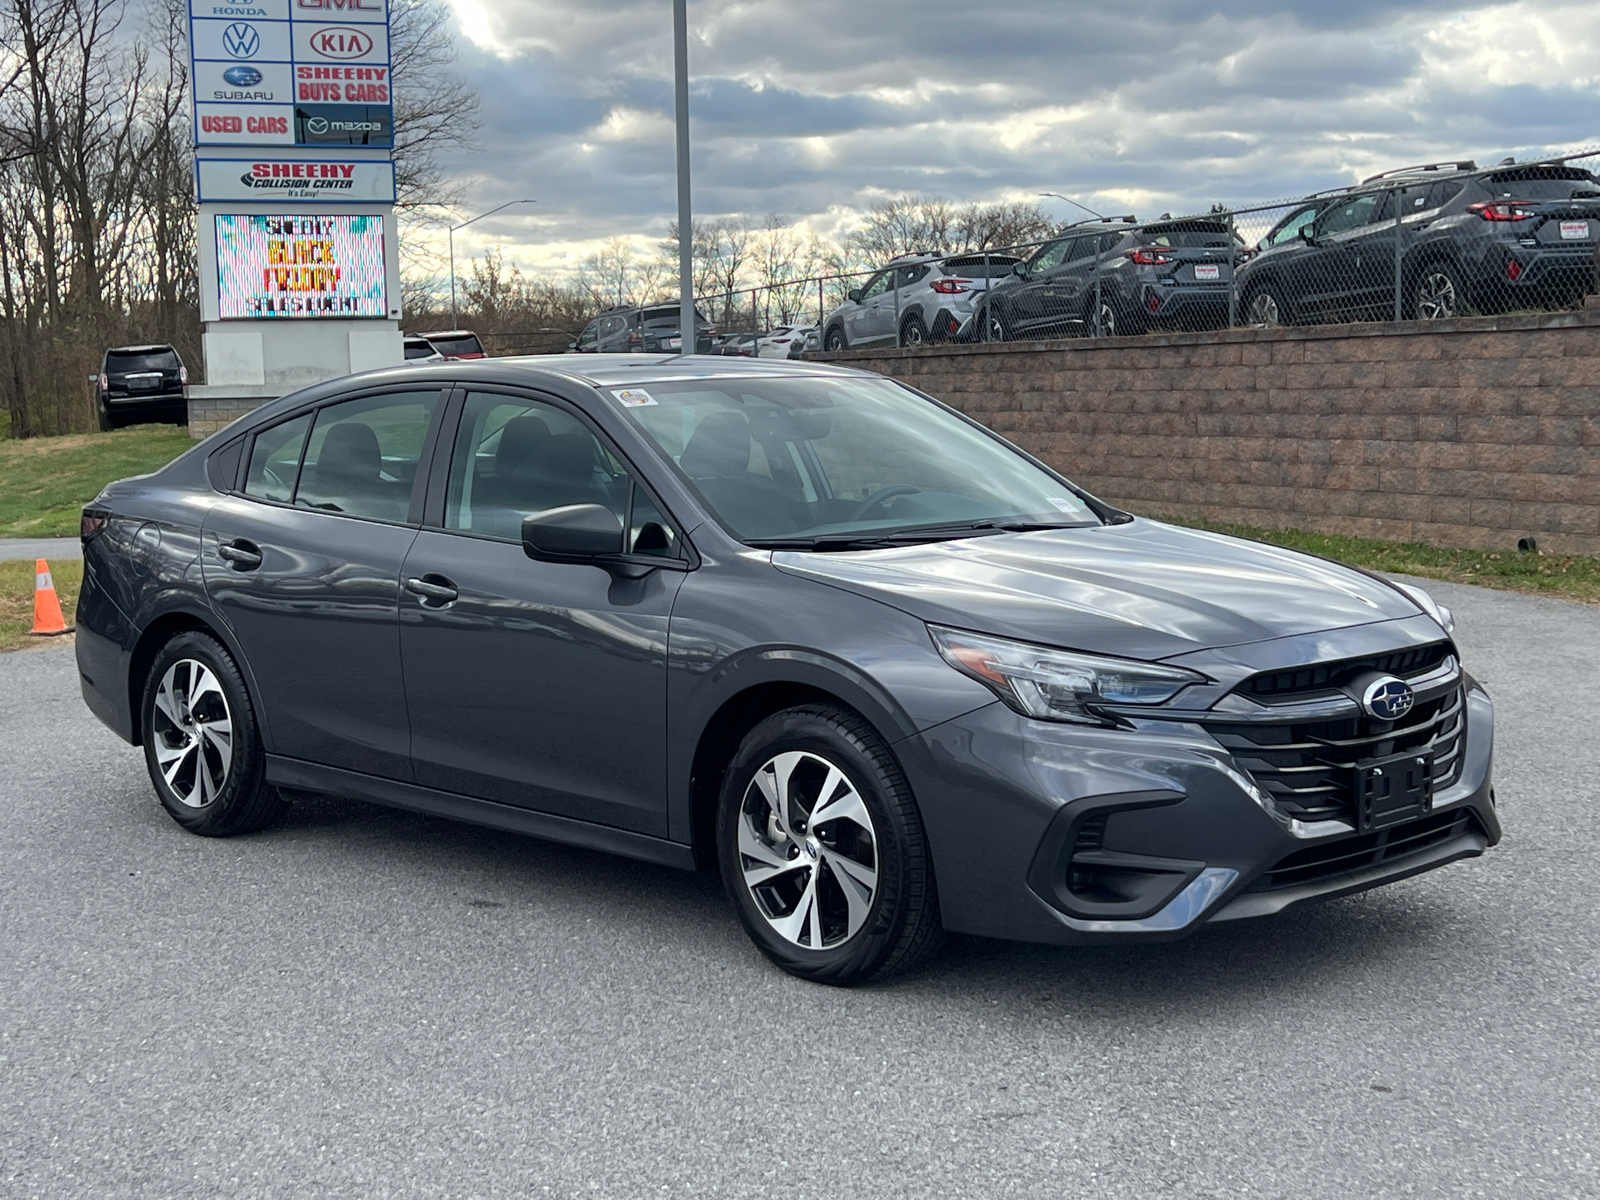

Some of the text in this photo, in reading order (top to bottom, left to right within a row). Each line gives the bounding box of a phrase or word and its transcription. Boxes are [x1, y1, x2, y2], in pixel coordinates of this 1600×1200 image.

[212, 6, 268, 16] HONDA
[321, 34, 364, 53] KIA
[297, 66, 388, 81] SHEEHY
[213, 90, 274, 101] SUBARU
[299, 82, 389, 103] BUYS CARS
[201, 115, 289, 134] USED CARS
[252, 163, 356, 178] SHEEHY
[253, 179, 354, 189] COLLISION CENTER
[287, 189, 320, 198] It's Easy!
